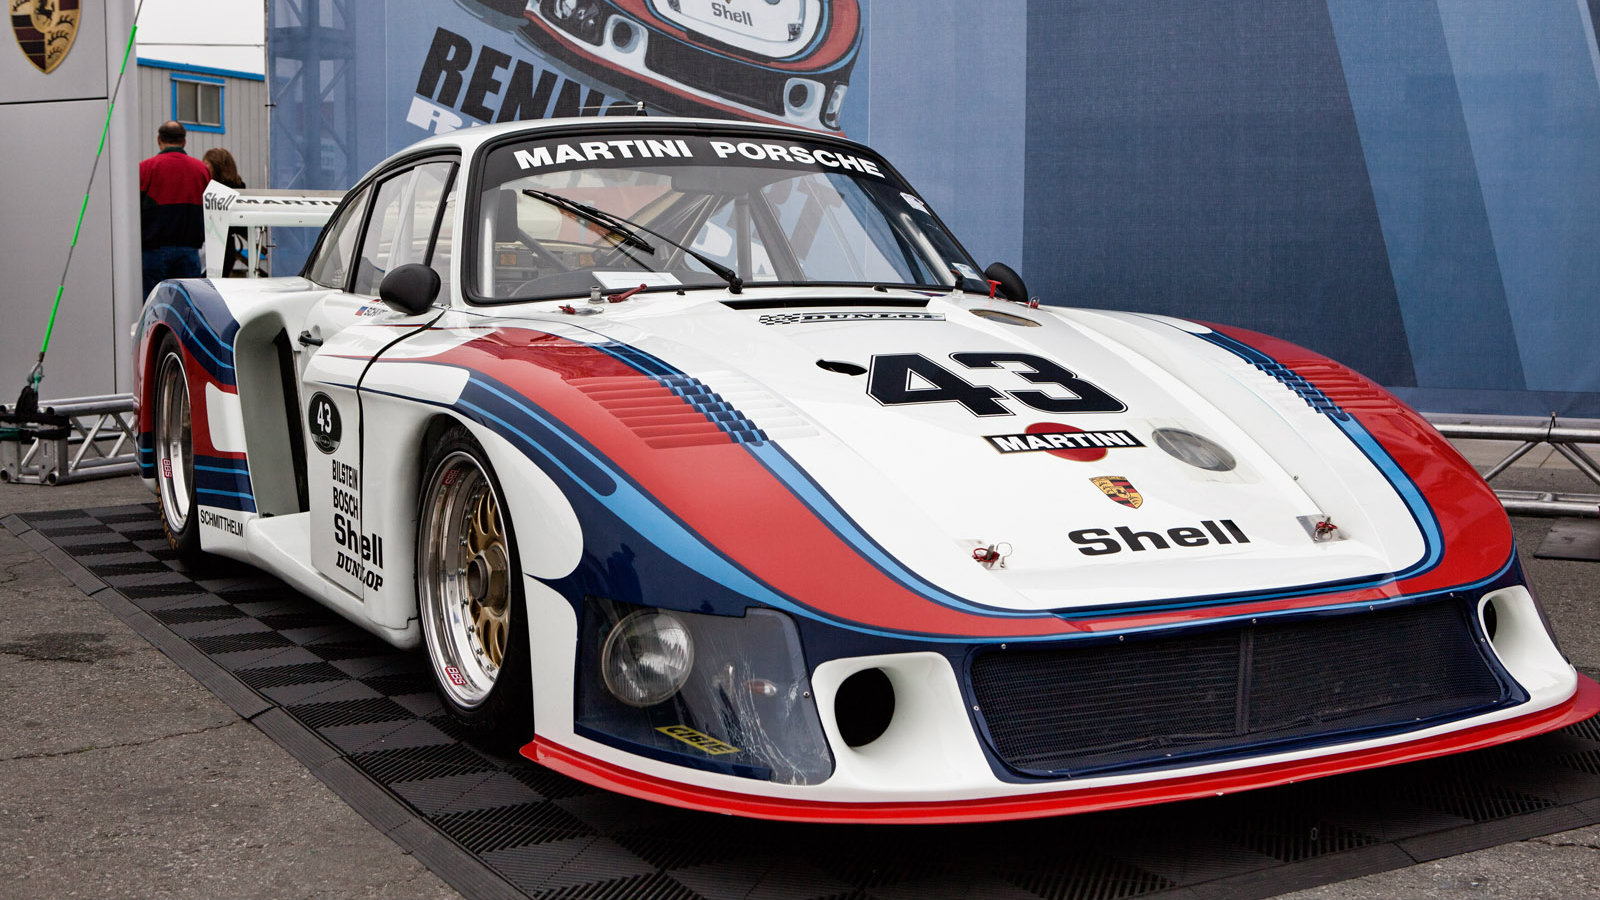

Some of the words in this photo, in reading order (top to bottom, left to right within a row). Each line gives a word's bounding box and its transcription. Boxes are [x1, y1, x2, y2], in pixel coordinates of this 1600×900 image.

[711, 3, 753, 26] Shell
[513, 139, 694, 170] MARTINI
[709, 141, 886, 179] PORSCHE
[204, 192, 236, 211] Shell
[866, 352, 1129, 418] 43
[317, 401, 332, 434] 43
[992, 431, 1136, 452] MARTINI
[163, 459, 172, 477] BBS
[332, 459, 358, 491] BILSTEIN
[333, 486, 359, 520] BOSCH
[200, 509, 244, 538] SCHMITTHELM
[1068, 519, 1251, 556] Shell
[334, 513, 384, 569] Shell
[336, 551, 384, 592] DUNLOP
[447, 667, 464, 685] BBS
